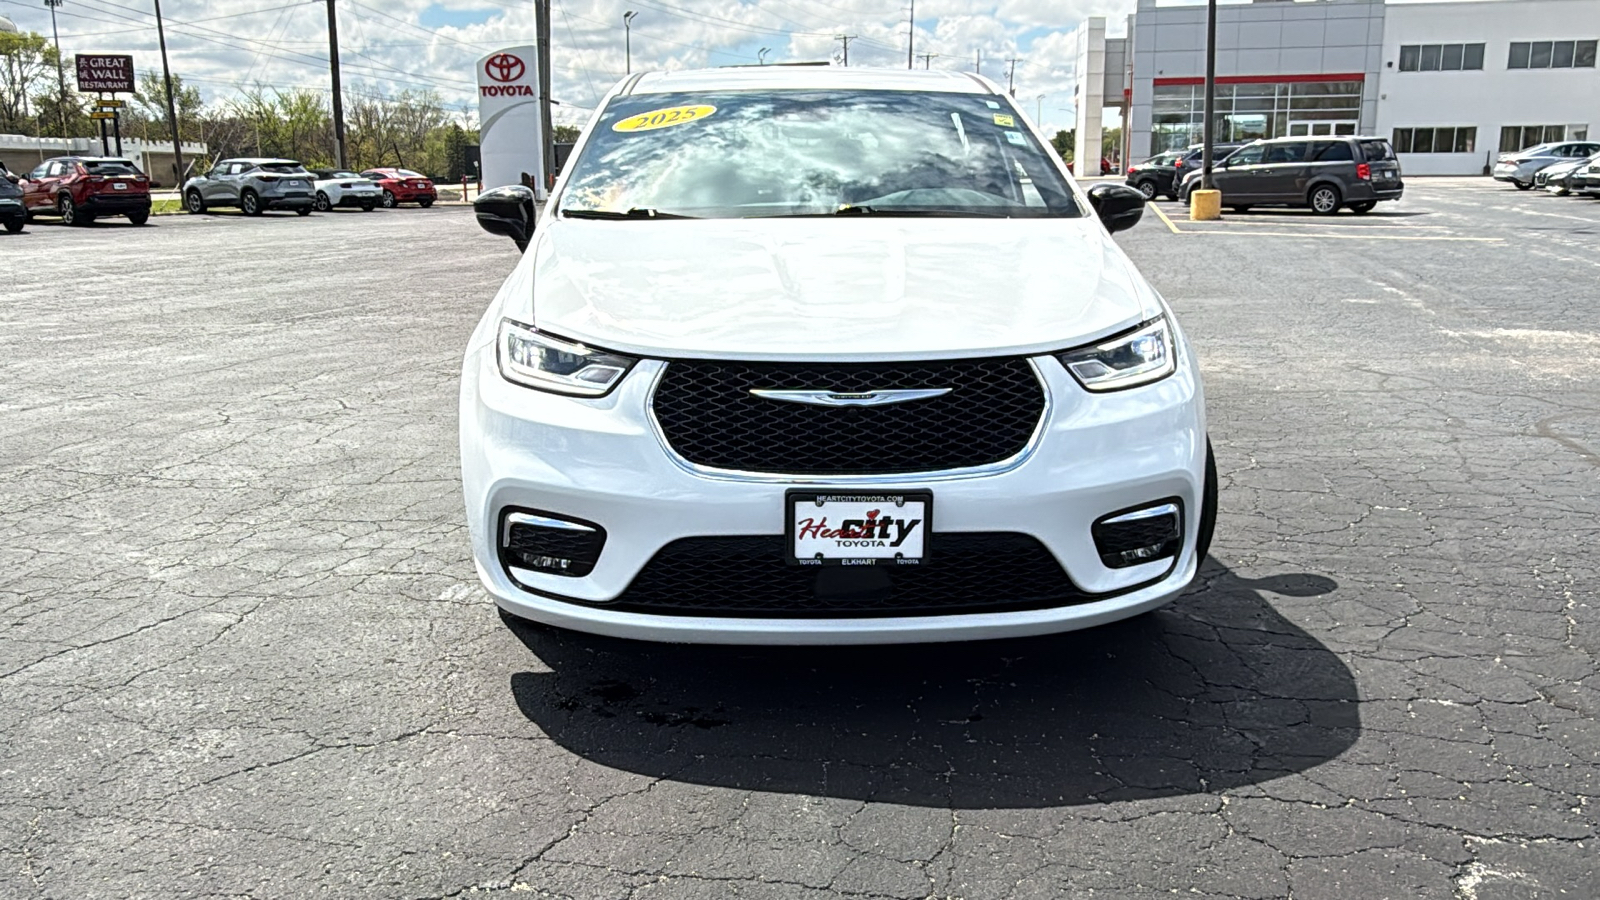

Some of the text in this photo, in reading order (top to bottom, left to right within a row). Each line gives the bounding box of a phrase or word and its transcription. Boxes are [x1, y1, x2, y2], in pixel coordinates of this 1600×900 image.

[90, 58, 126, 68] GREAT
[91, 69, 126, 79] WALL
[79, 81, 129, 89] RESTAURANT
[480, 85, 534, 97] TOYOTA
[633, 107, 698, 129] 2025
[798, 516, 885, 540] Heart
[835, 540, 885, 548] TOYOTA
[841, 558, 877, 566] ELKHART
